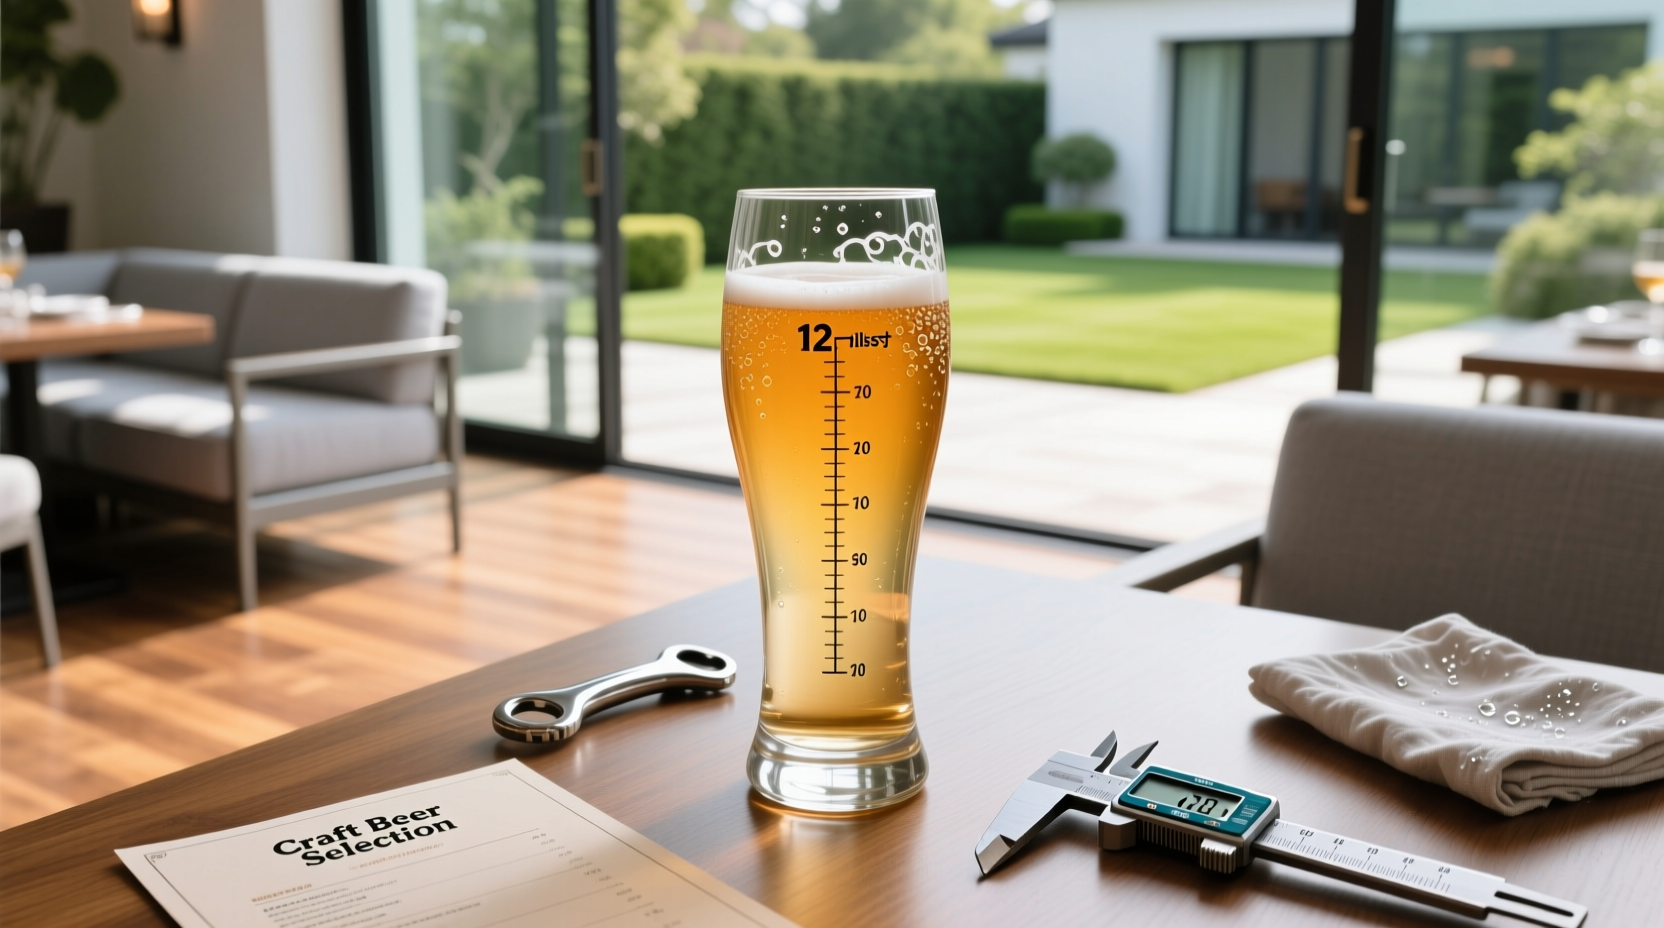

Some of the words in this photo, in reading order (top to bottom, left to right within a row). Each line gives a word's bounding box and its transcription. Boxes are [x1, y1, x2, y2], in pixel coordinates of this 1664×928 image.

[797, 323, 833, 352] 12
[272, 823, 363, 856] Craft
[364, 805, 441, 833] Beer
[300, 819, 458, 867] Selection
